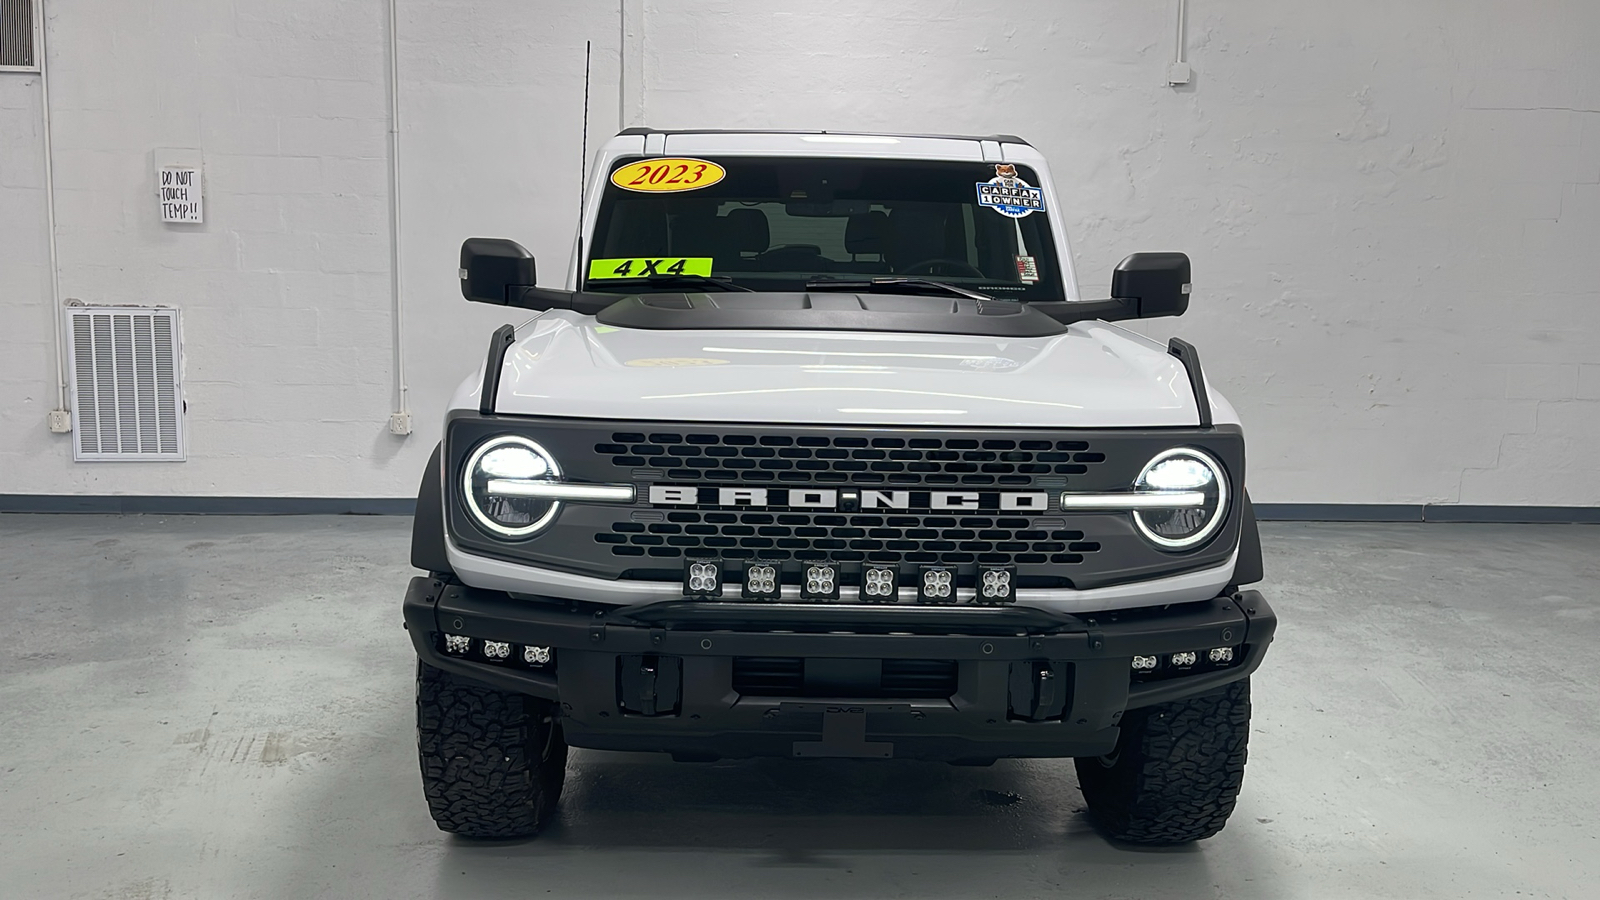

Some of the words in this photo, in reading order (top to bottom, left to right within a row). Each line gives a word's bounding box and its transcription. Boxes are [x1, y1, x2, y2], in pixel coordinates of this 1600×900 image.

[162, 171, 172, 186] DO
[176, 171, 194, 186] NOT
[628, 164, 708, 185] 2023
[161, 187, 188, 201] TOUCH
[981, 186, 1039, 199] CARFAX
[162, 203, 197, 219] TEMP!!
[649, 484, 1048, 511] BRONCO
